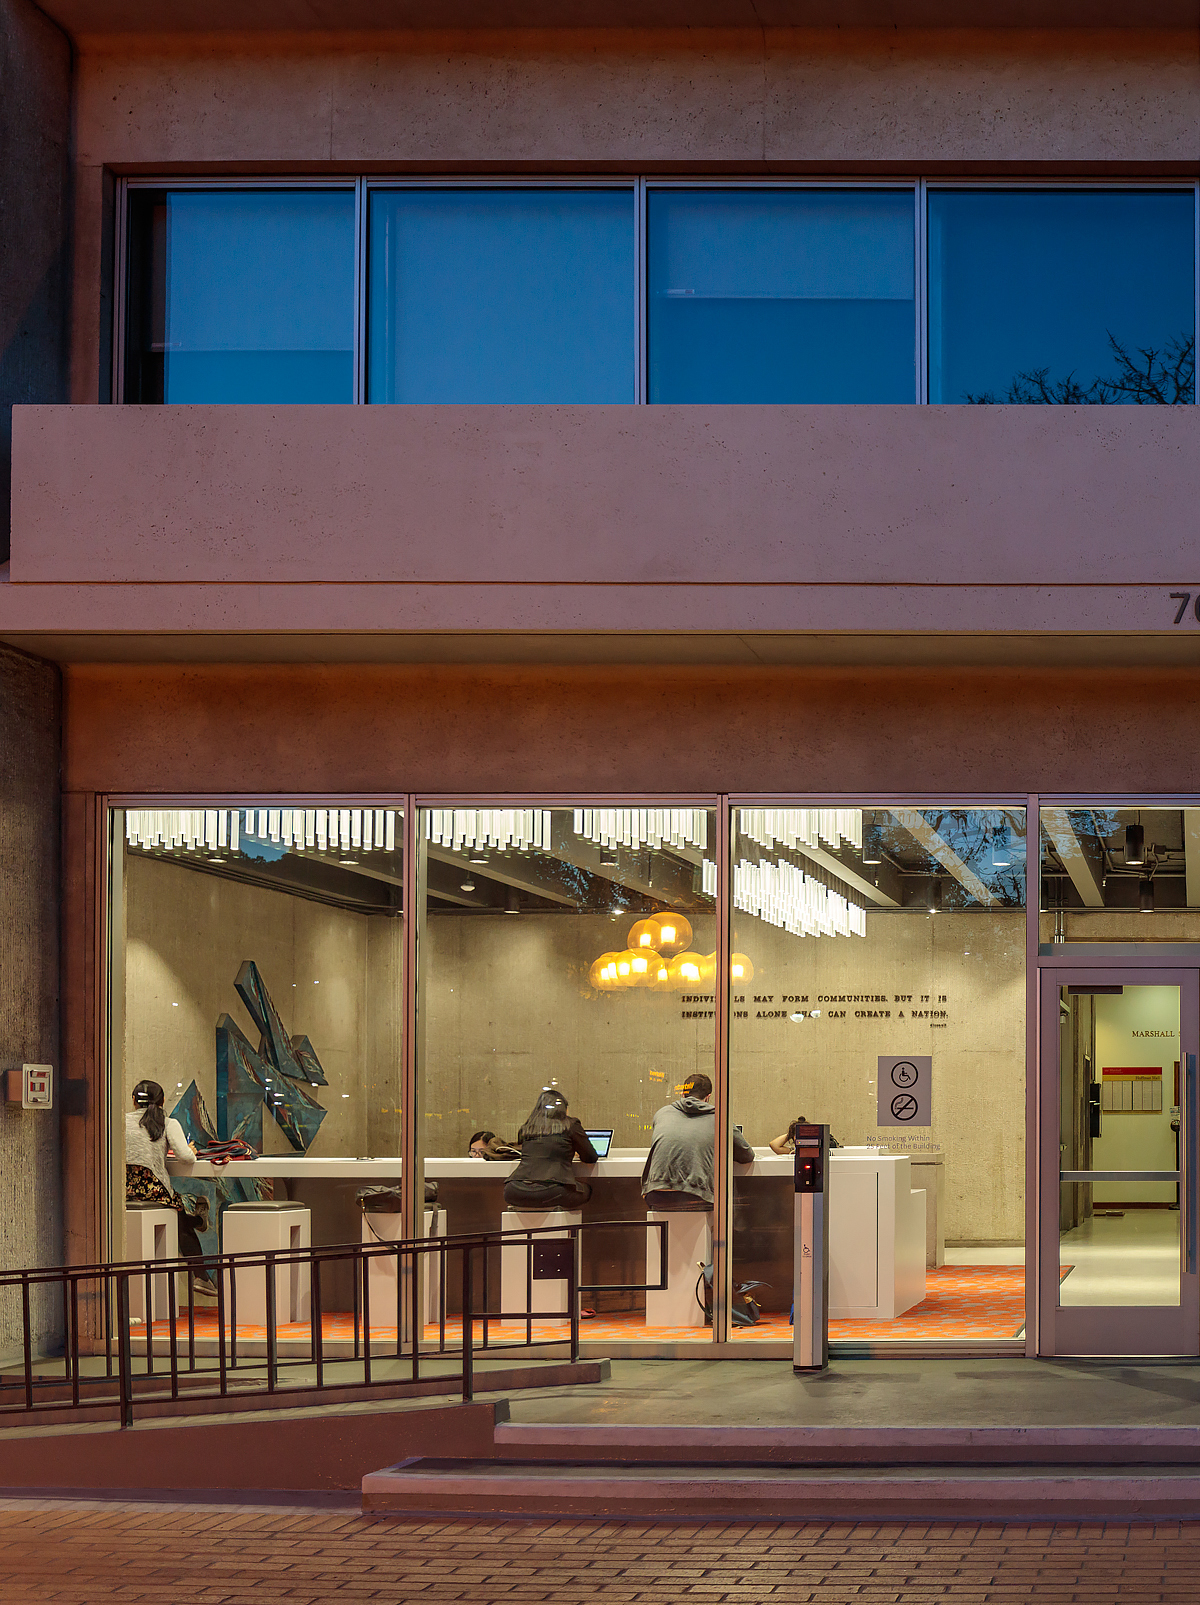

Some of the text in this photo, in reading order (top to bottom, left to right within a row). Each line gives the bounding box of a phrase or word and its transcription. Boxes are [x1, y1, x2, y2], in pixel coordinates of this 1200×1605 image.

[681, 995, 745, 1003] INDIVILS
[754, 995, 774, 1003] MAY
[782, 995, 809, 1003] FORM
[920, 995, 930, 1003] IT
[938, 995, 947, 1003] IS
[1132, 1030, 1176, 1038] MARSHALL
[878, 1135, 907, 1143] Smoking
[908, 1134, 931, 1142] Within
[913, 1143, 941, 1151] Building
